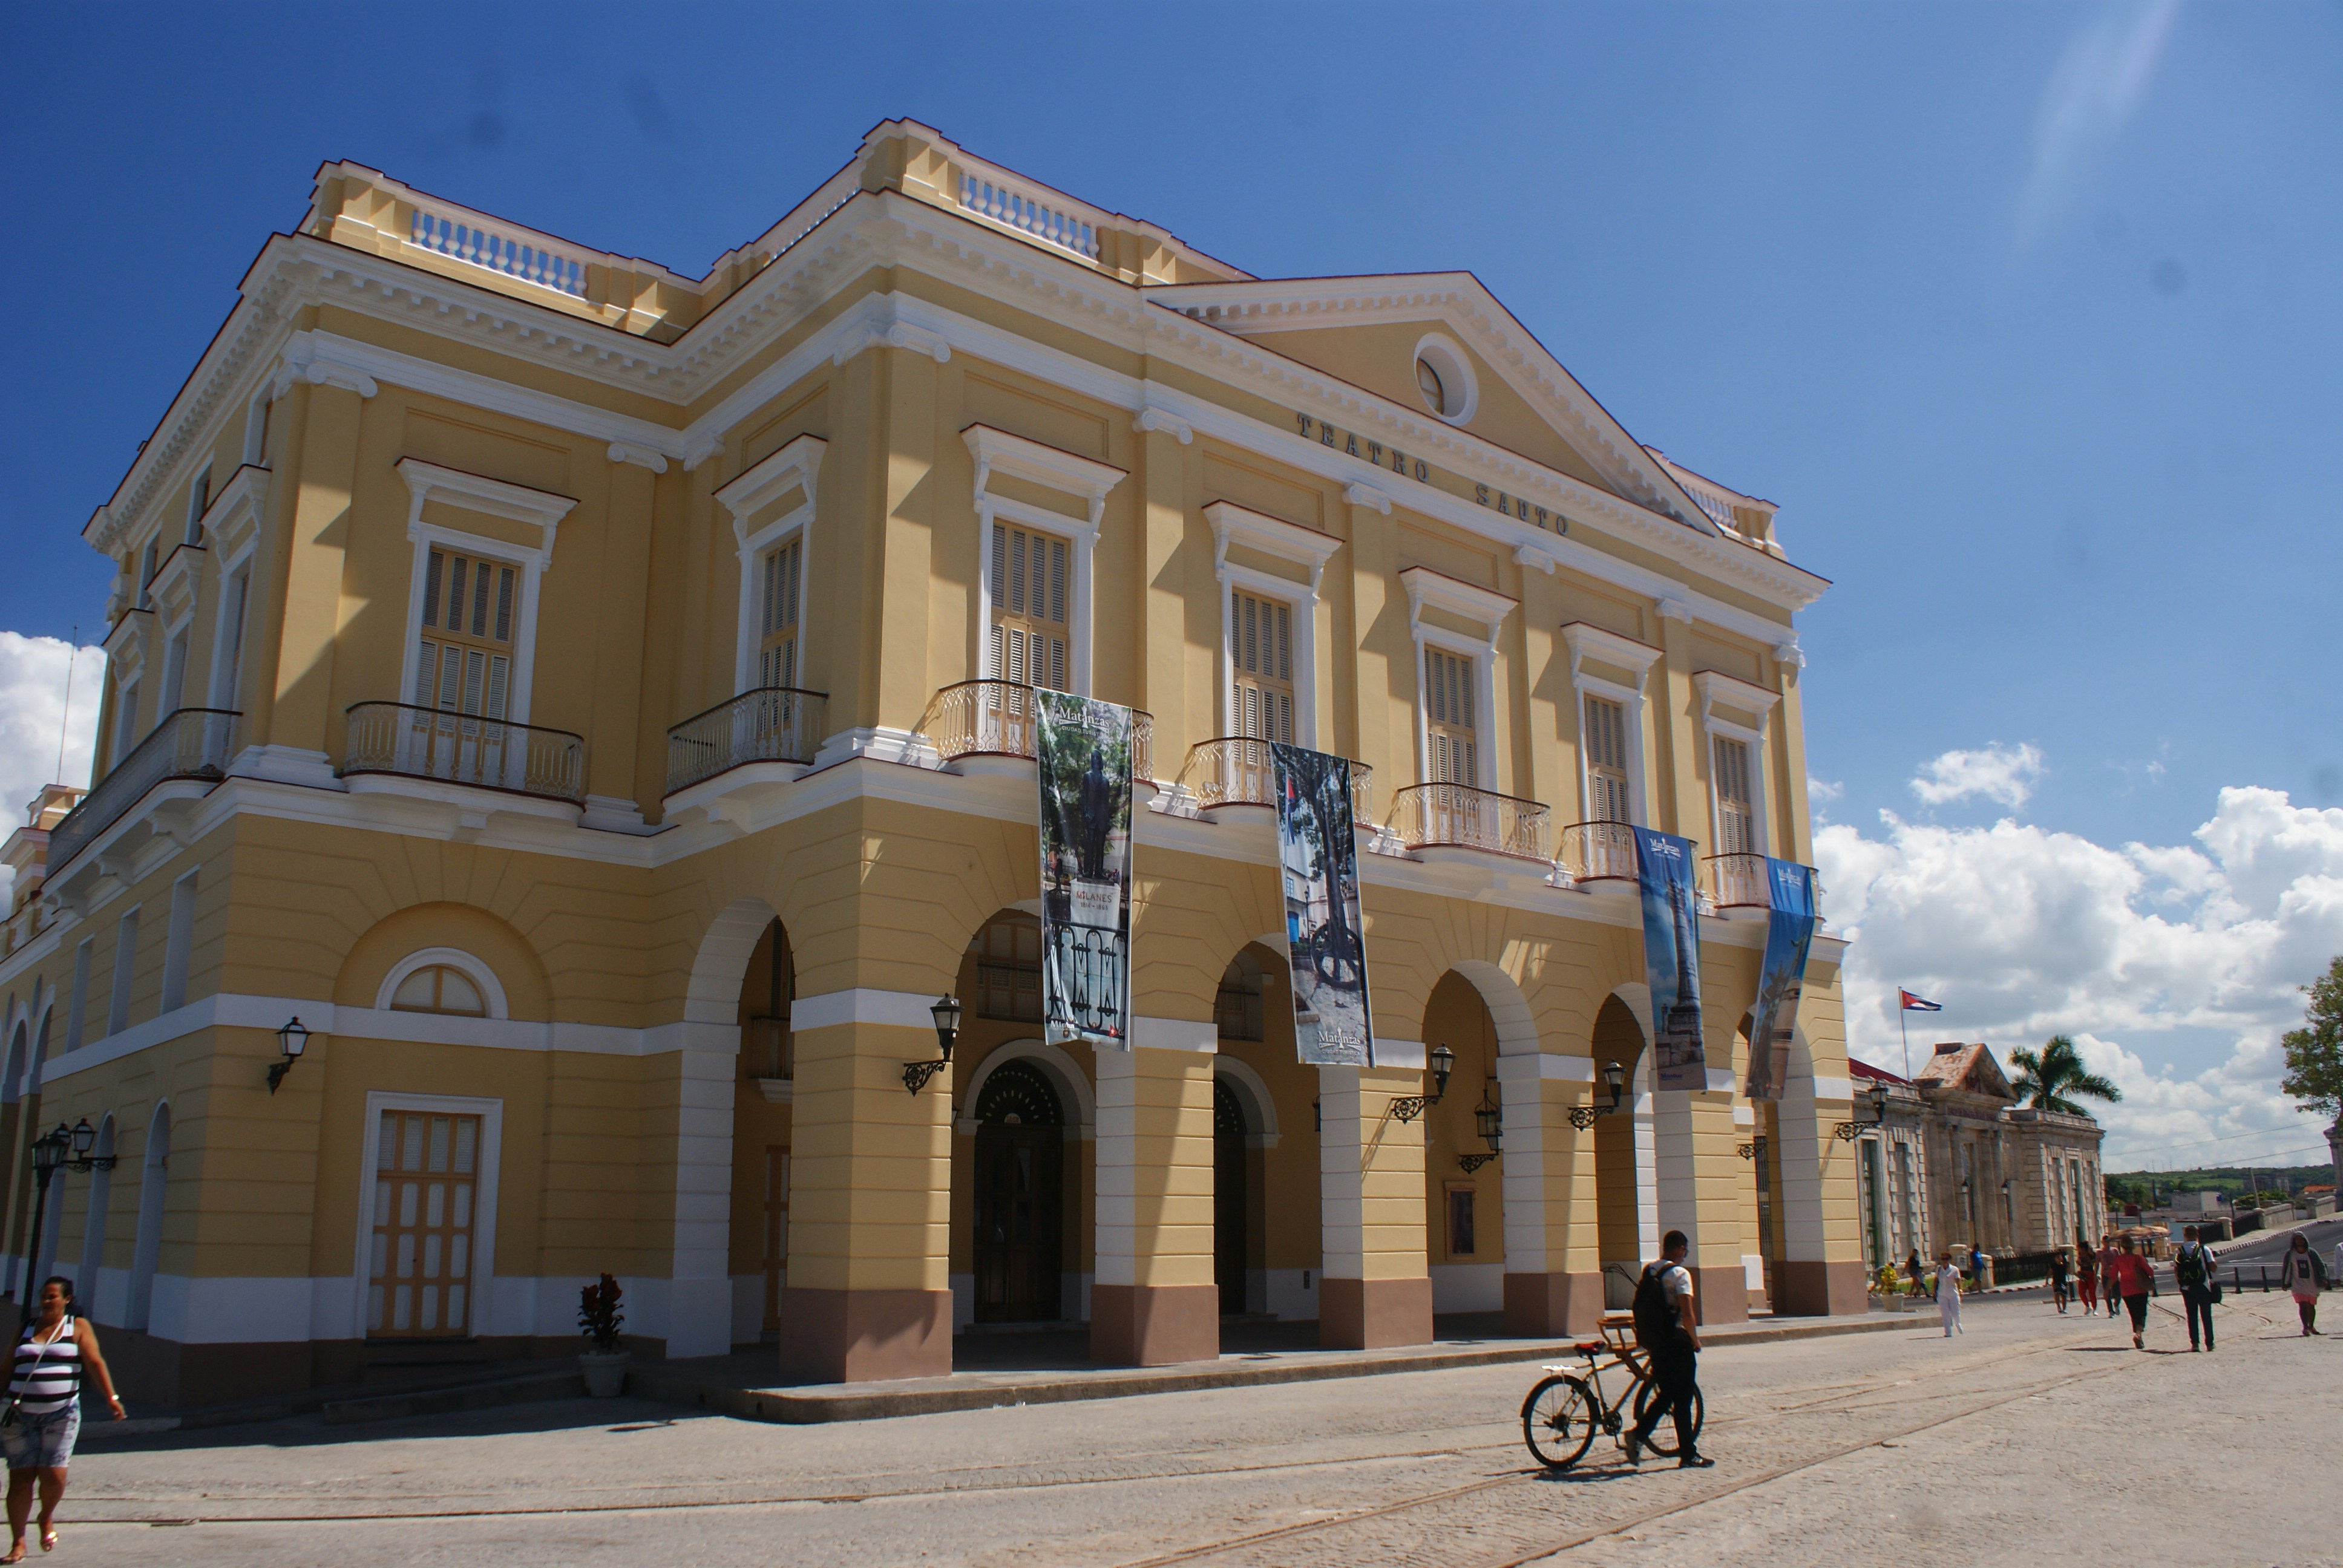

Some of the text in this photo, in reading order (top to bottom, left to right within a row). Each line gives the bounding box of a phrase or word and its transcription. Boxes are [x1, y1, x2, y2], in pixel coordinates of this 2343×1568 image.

[1298, 413, 1568, 536] TEATRO SAUTO
[1059, 706, 1110, 727] Matanzas
[1318, 1030, 1360, 1045] Matanzas
